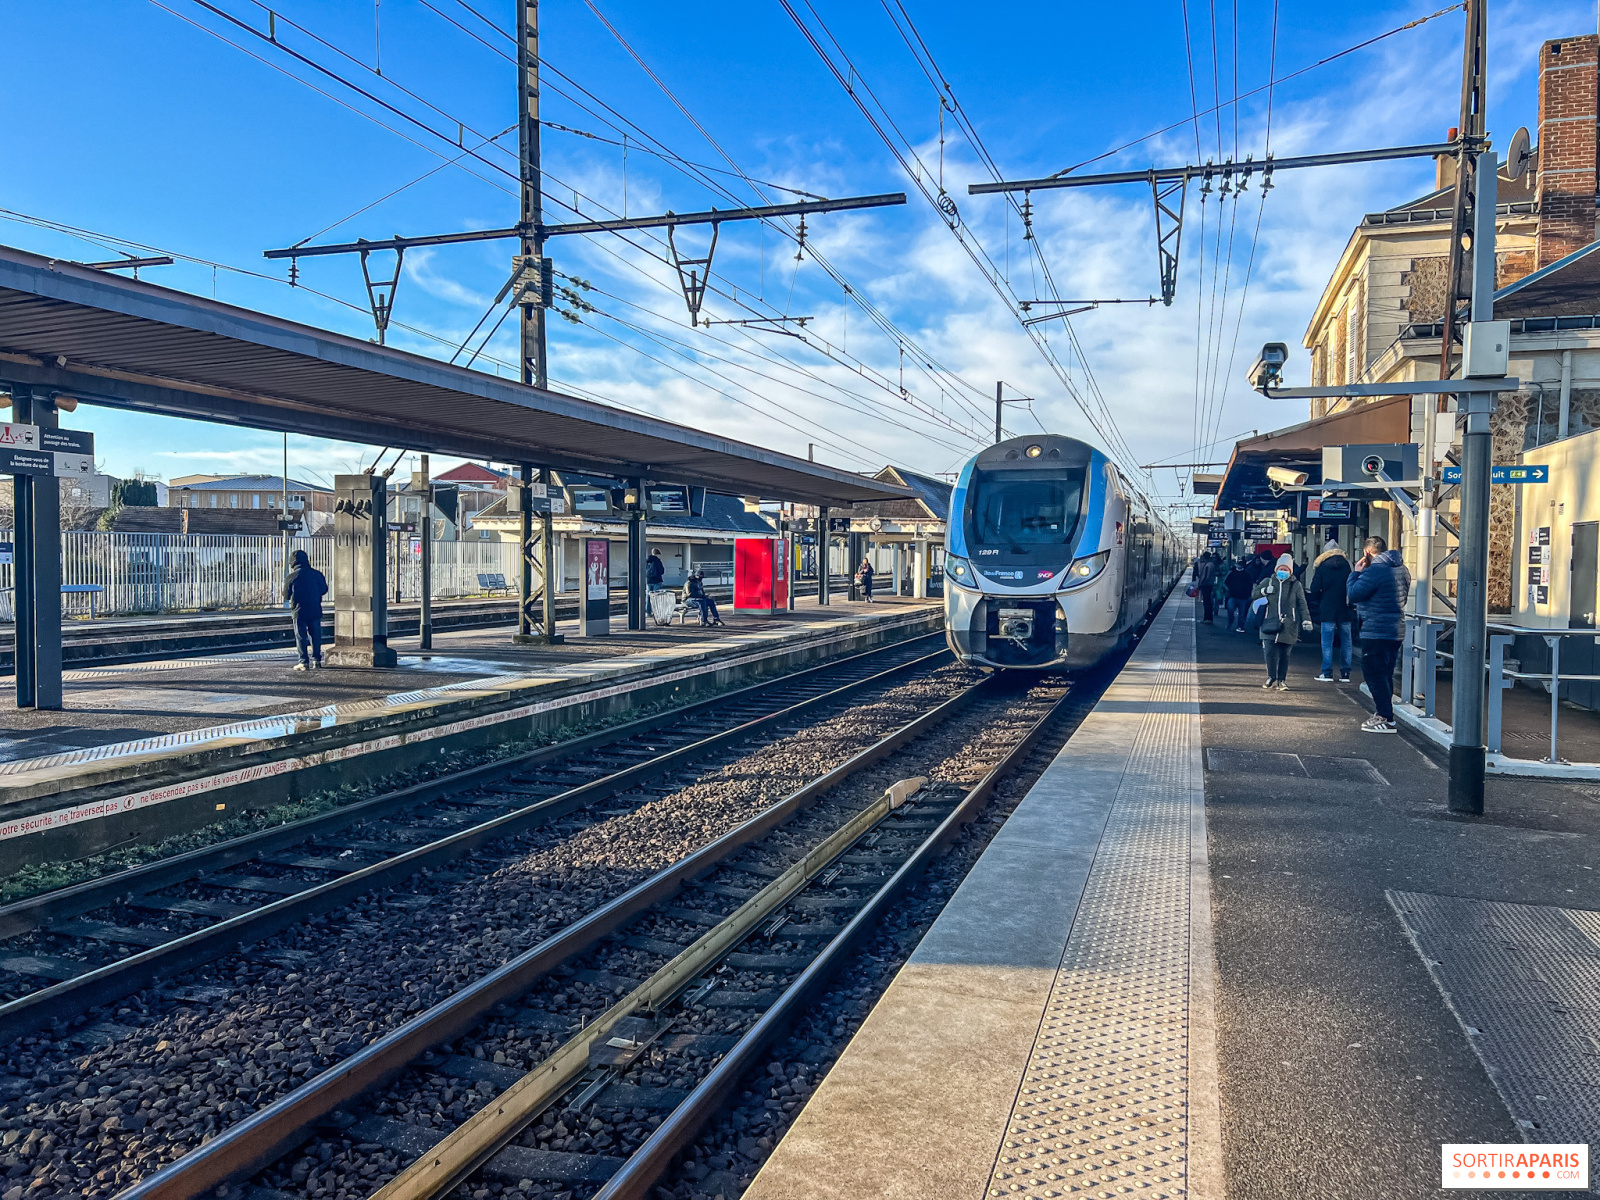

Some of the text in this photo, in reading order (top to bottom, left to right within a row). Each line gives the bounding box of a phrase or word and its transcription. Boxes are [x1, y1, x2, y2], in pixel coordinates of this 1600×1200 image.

[20, 814, 53, 831] sécurité
[59, 814, 68, 822] ne
[70, 806, 104, 820] traversez
[105, 802, 118, 814] pas
[140, 795, 149, 804] ne
[150, 786, 186, 801] descendez
[187, 783, 199, 795] pas
[200, 780, 211, 789] sur
[211, 777, 221, 786] les
[222, 774, 238, 784] voies
[264, 761, 287, 774] DANGER
